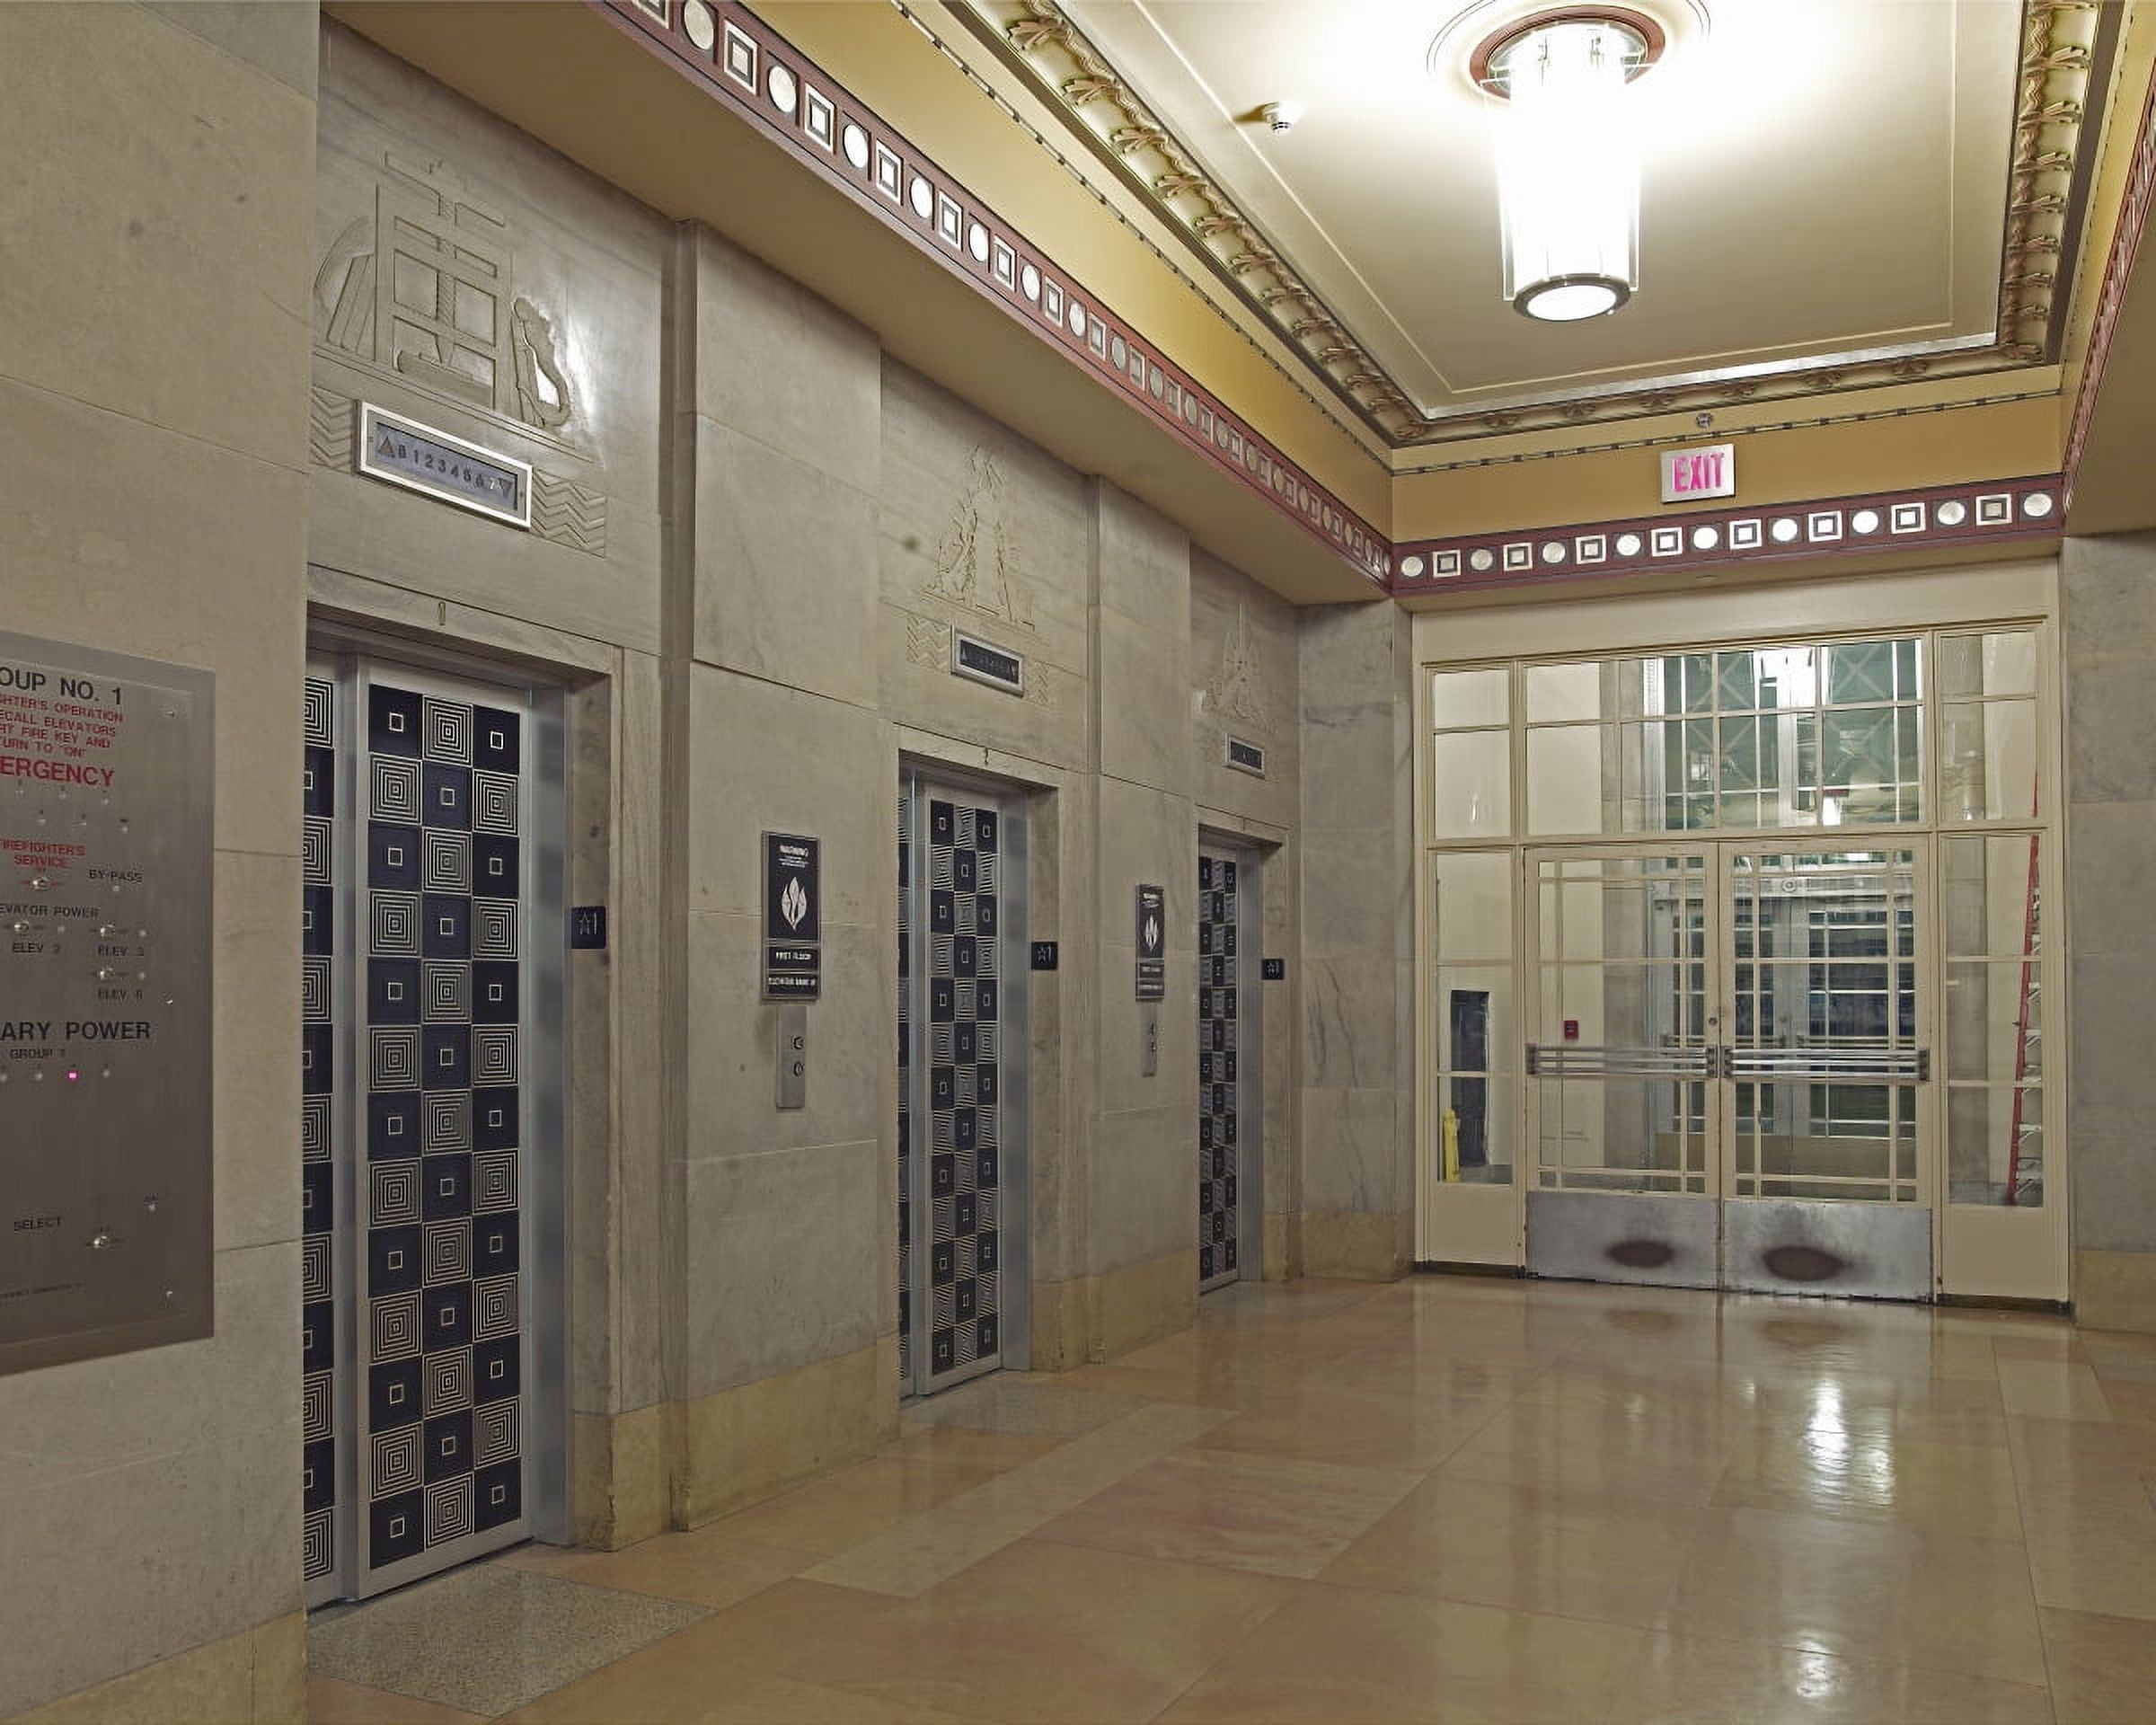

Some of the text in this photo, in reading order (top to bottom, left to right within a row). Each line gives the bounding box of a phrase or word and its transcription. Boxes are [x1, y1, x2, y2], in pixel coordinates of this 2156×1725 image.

[413, 449, 419, 464] 1
[425, 454, 433, 468] 2
[437, 459, 446, 473] 3
[450, 464, 459, 478] 4
[1672, 453, 1724, 492] EXIT
[59, 677, 100, 700] NO.
[111, 686, 121, 705] 1
[54, 703, 124, 723] OPERATION
[44, 716, 116, 738] ELEVATORS
[22, 726, 48, 740] FIRE
[54, 731, 79, 744] KEY
[85, 735, 110, 748] AND
[54, 906, 99, 918] POWER
[12, 942, 44, 954] ELEV
[97, 944, 128, 958] ELEV
[97, 989, 128, 1001] ELEV
[65, 1022, 151, 1040] POWER
[10, 1048, 53, 1060] GROUP
[13, 1216, 61, 1233] SELECT
